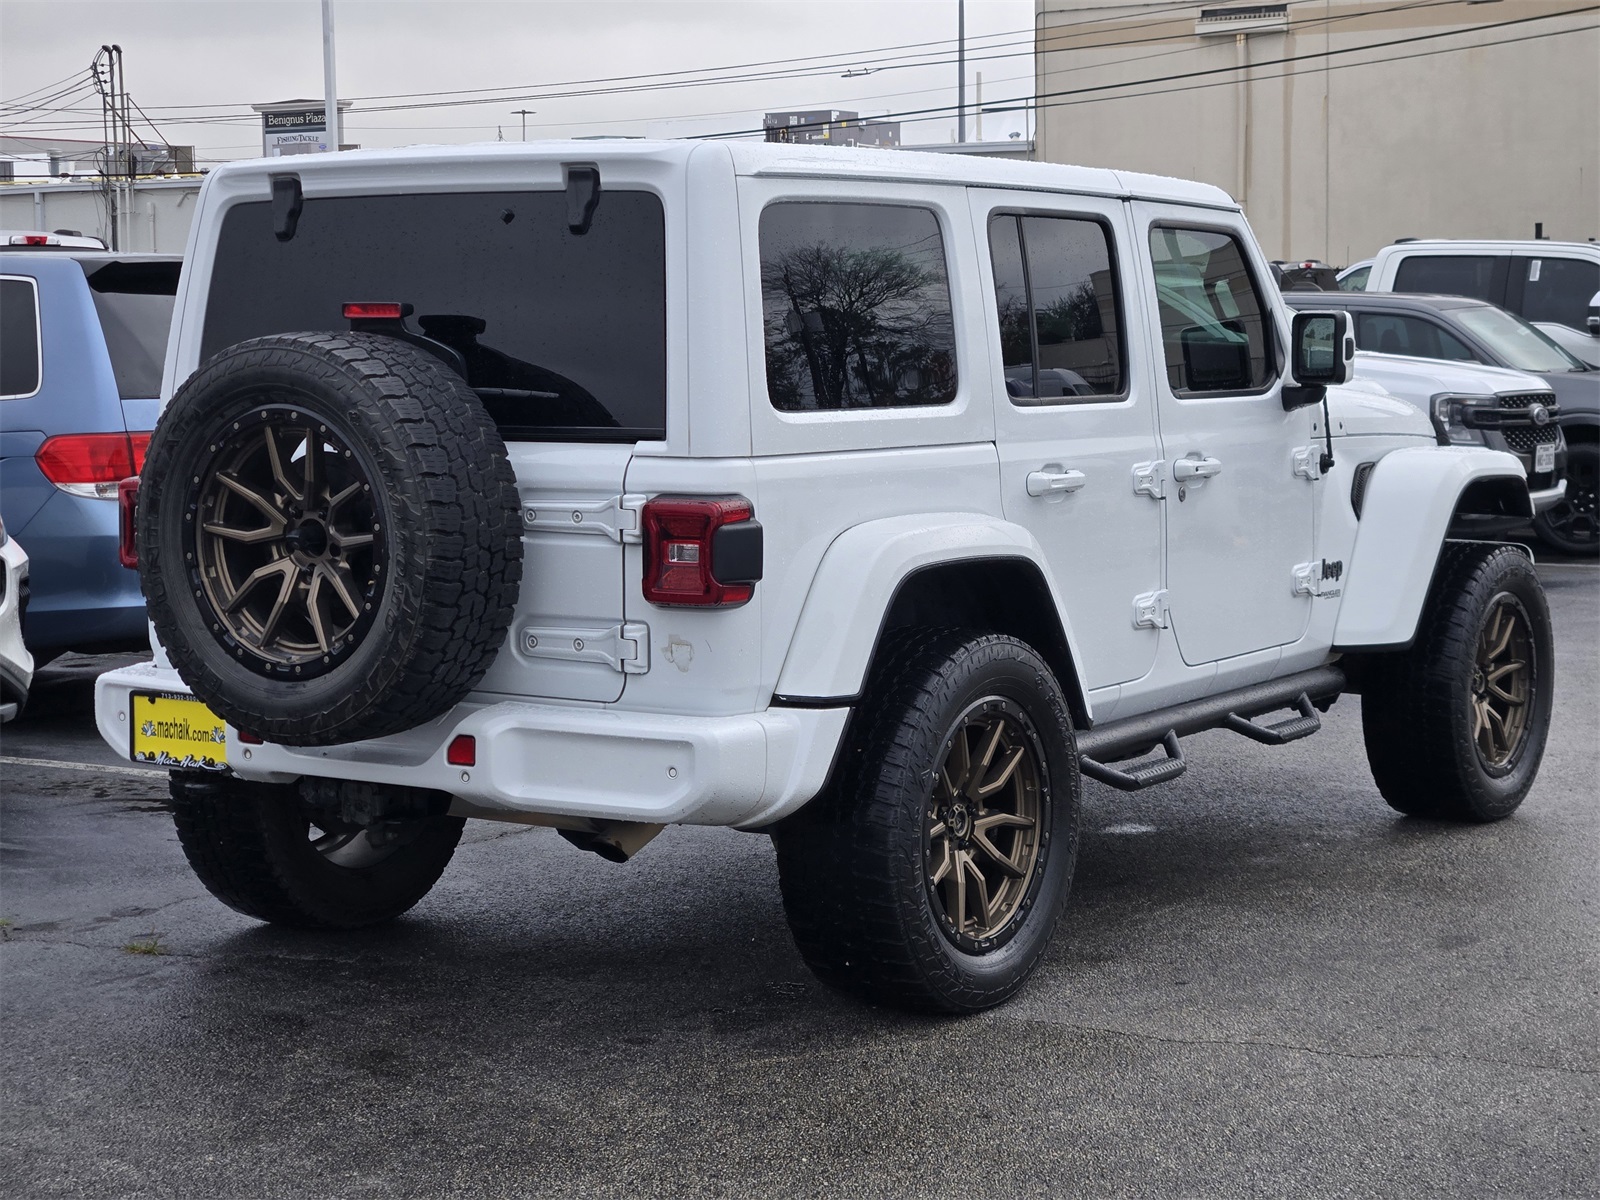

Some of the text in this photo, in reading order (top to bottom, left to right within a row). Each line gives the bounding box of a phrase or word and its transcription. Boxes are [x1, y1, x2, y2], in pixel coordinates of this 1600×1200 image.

[268, 113, 326, 126] Benignus Plaza
[1321, 558, 1343, 581] Jeep
[157, 717, 210, 743] machaik.com
[155, 751, 178, 765] Mac
